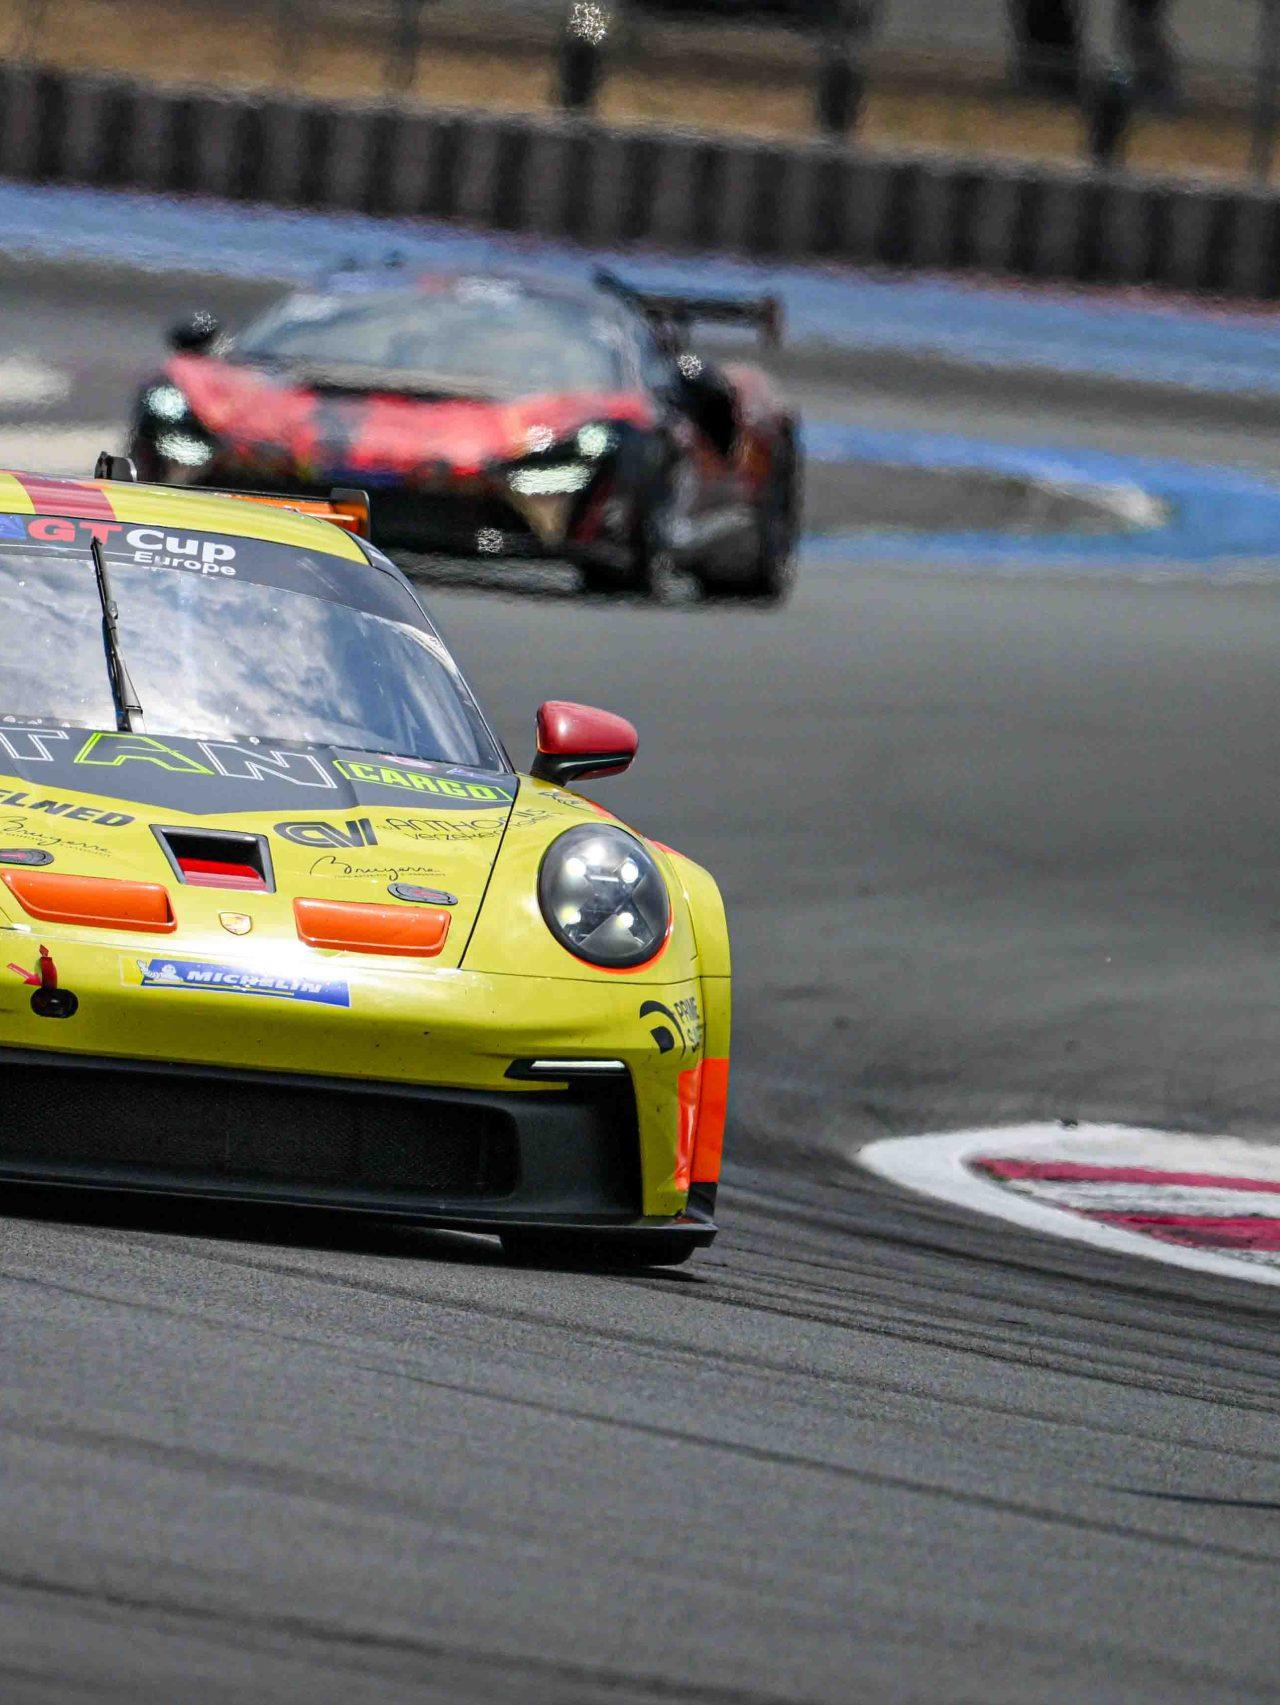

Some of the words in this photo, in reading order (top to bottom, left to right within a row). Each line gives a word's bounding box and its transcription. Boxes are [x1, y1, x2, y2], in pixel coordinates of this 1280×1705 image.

[27, 518, 123, 545] GT
[125, 528, 238, 563] Cup
[133, 550, 238, 576] Europe
[347, 762, 498, 800] CARGO
[186, 969, 322, 994] MICHELIN
